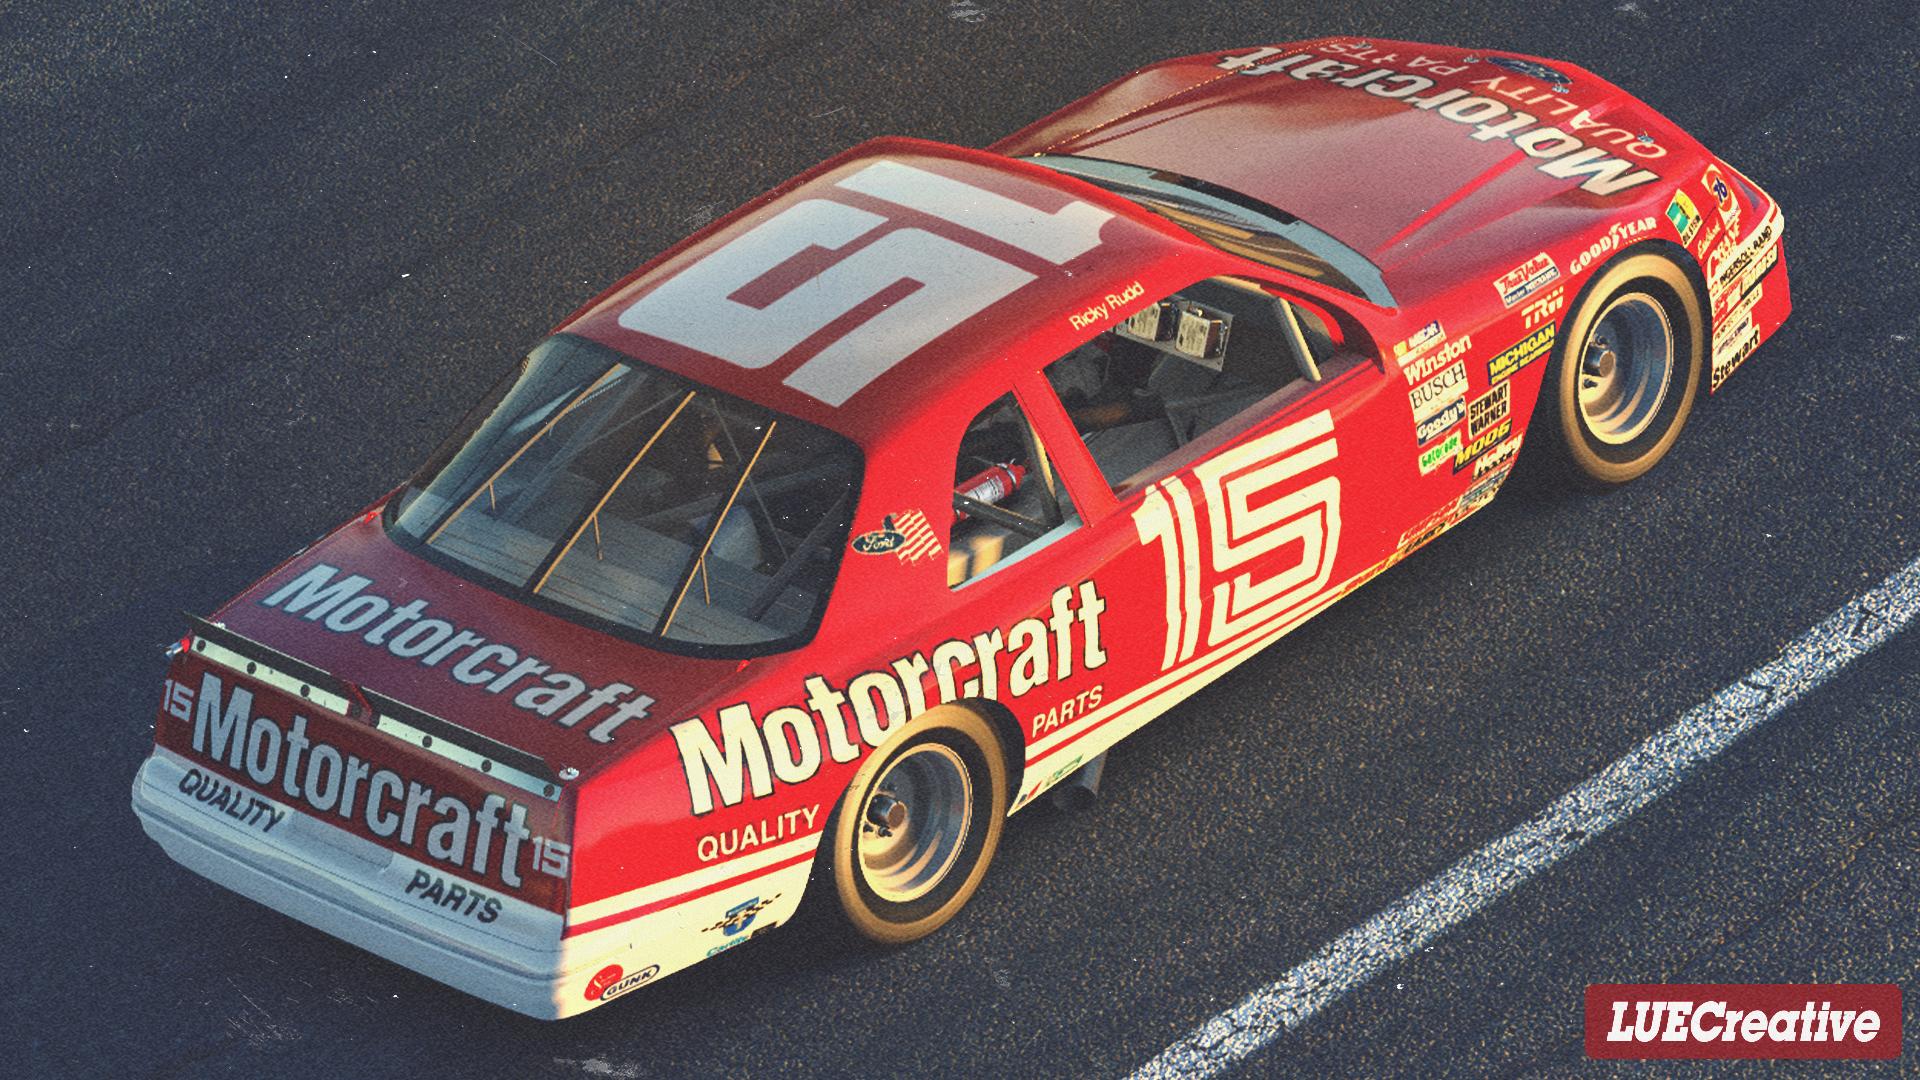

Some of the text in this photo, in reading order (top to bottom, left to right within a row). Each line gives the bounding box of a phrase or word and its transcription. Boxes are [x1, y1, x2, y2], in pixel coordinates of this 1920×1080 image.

[1216, 45, 1662, 196] Motorcraft
[1469, 75, 1668, 160] QUALITY
[1569, 216, 1657, 275] GOODYEAR
[617, 159, 1116, 408] 15
[1068, 297, 1109, 331] Ricky
[1106, 281, 1145, 313] Rudd
[1521, 286, 1564, 329] TRW
[1403, 335, 1472, 386] Winston
[1489, 323, 1555, 376] MICHIGAN
[1711, 330, 1759, 388] Stewart
[1411, 363, 1465, 410] BUSCH
[1470, 384, 1508, 420] STEWART
[1470, 403, 1507, 437] WARNER
[1131, 409, 1342, 671] 15
[262, 562, 656, 743] Motorcraft
[669, 580, 1107, 816] Motorcraft
[162, 671, 571, 889] 15 Motorcraft 15
[697, 684, 1103, 862] QUALITY PARTS
[178, 767, 503, 923] QUALITY PARTS
[606, 969, 652, 996] GUNK
